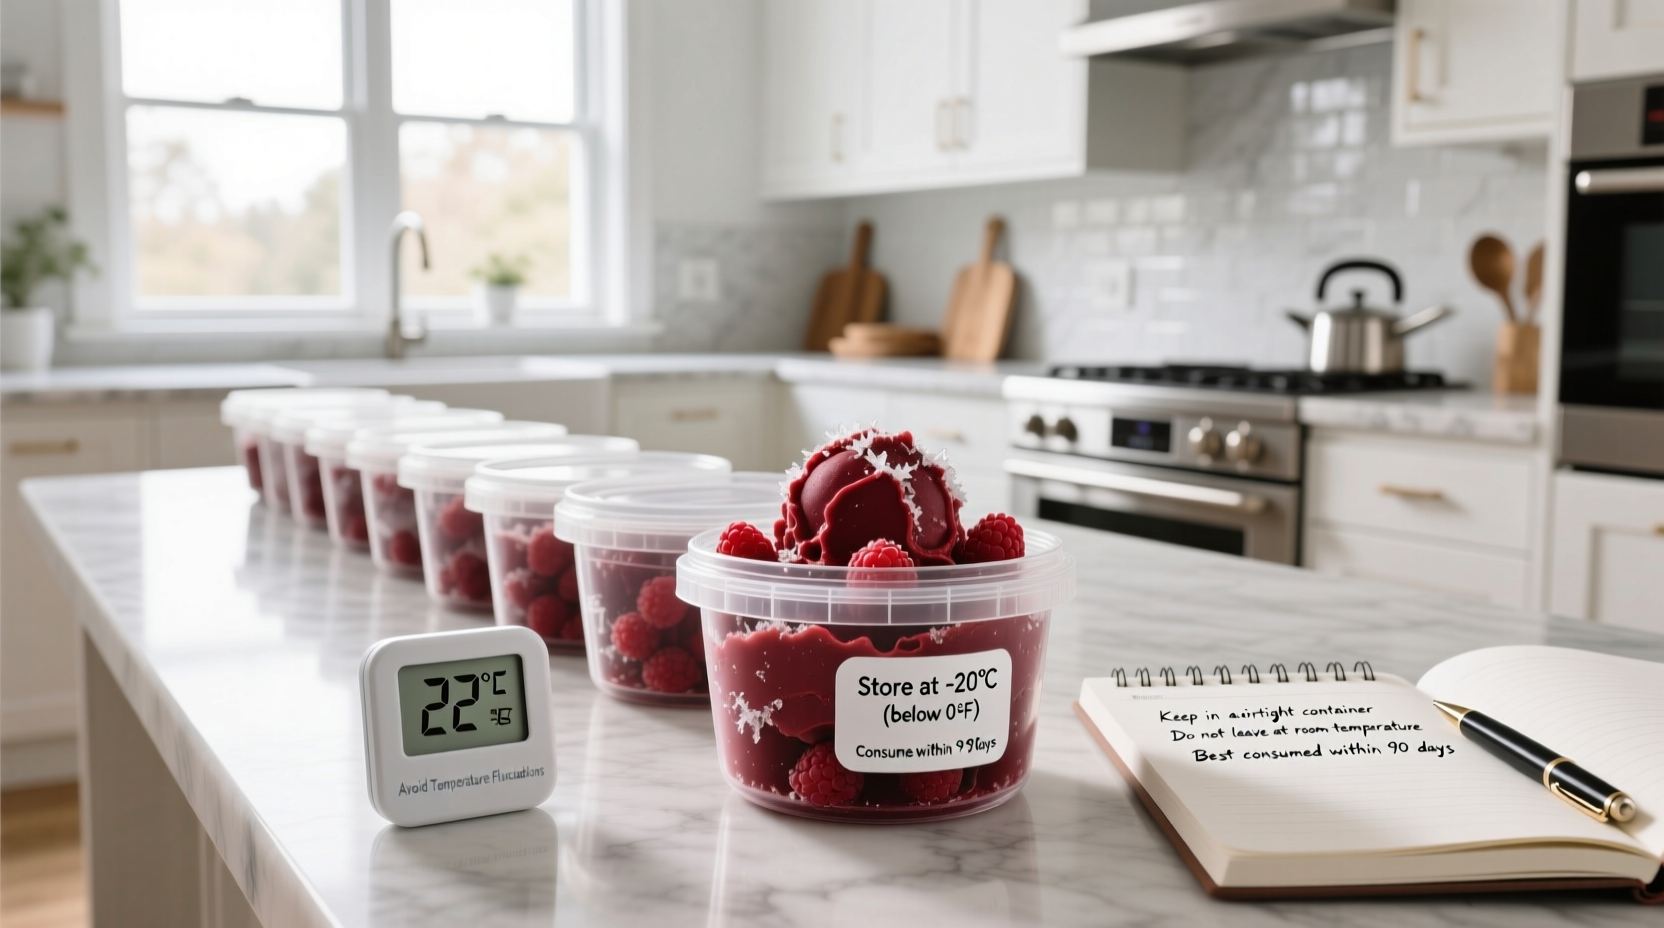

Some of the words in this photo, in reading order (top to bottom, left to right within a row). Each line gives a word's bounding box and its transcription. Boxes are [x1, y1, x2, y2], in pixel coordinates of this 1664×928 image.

[858, 676, 913, 696] Store
[919, 677, 939, 695] at
[946, 668, 998, 693] -20°C
[883, 704, 941, 728] (below
[1160, 710, 1198, 725] Keep
[1205, 710, 1220, 720] in
[1302, 705, 1373, 716] container
[1170, 730, 1195, 742] Do
[1201, 728, 1225, 739] not
[1232, 727, 1269, 738] leave
[1273, 725, 1288, 736] at
[1294, 727, 1329, 735] room
[1331, 720, 1423, 738] temperature
[916, 742, 953, 757] within
[1192, 749, 1234, 762] Best
[1243, 743, 1323, 760] consumed
[1329, 742, 1382, 756] within
[1387, 741, 1409, 755] 90
[1417, 741, 1456, 758] days
[398, 777, 428, 797] Avoid
